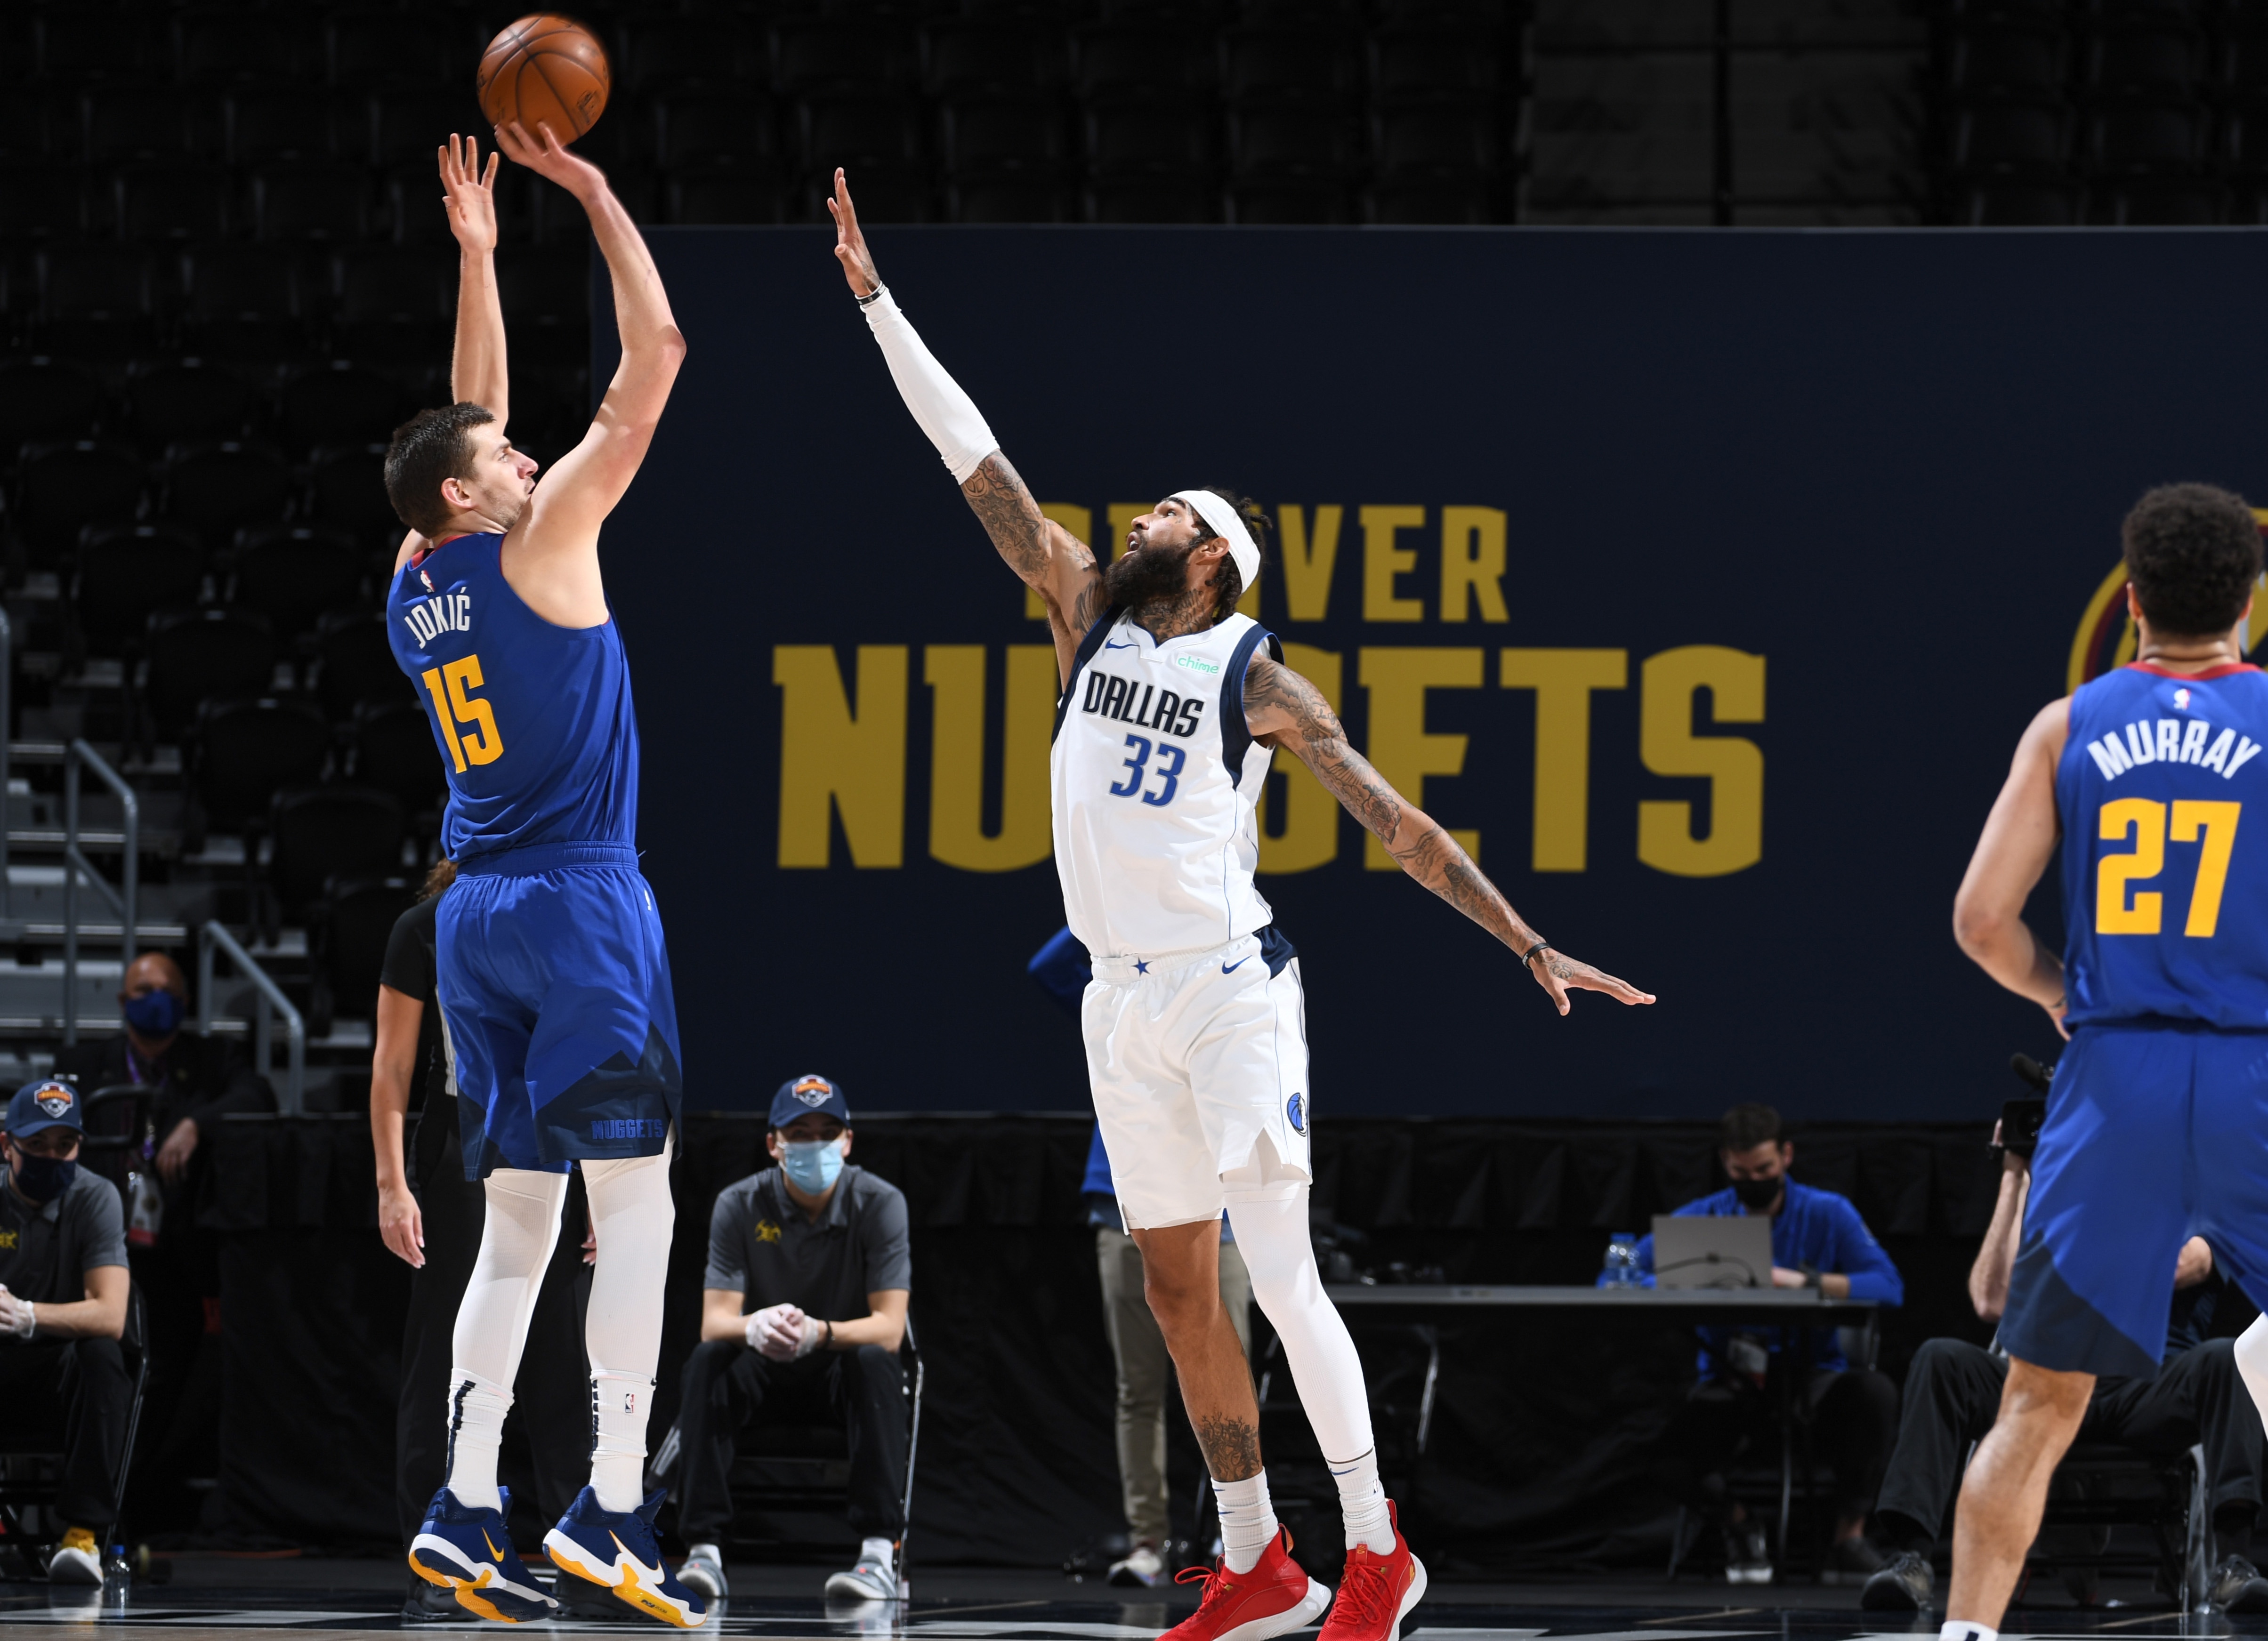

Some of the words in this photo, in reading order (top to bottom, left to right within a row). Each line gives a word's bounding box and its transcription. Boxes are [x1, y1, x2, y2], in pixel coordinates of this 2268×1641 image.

[1024, 502, 1510, 622] VER
[404, 587, 470, 649] JOKIĆ
[1177, 656, 1219, 674] chime
[421, 654, 504, 774] 15
[1081, 670, 1206, 739] DALLAS
[772, 642, 1768, 878] NUETS
[1108, 732, 1187, 808] 33
[2087, 719, 2263, 781] MURRAY
[2095, 797, 2242, 938] 27
[591, 1119, 664, 1140] NUGGETS
